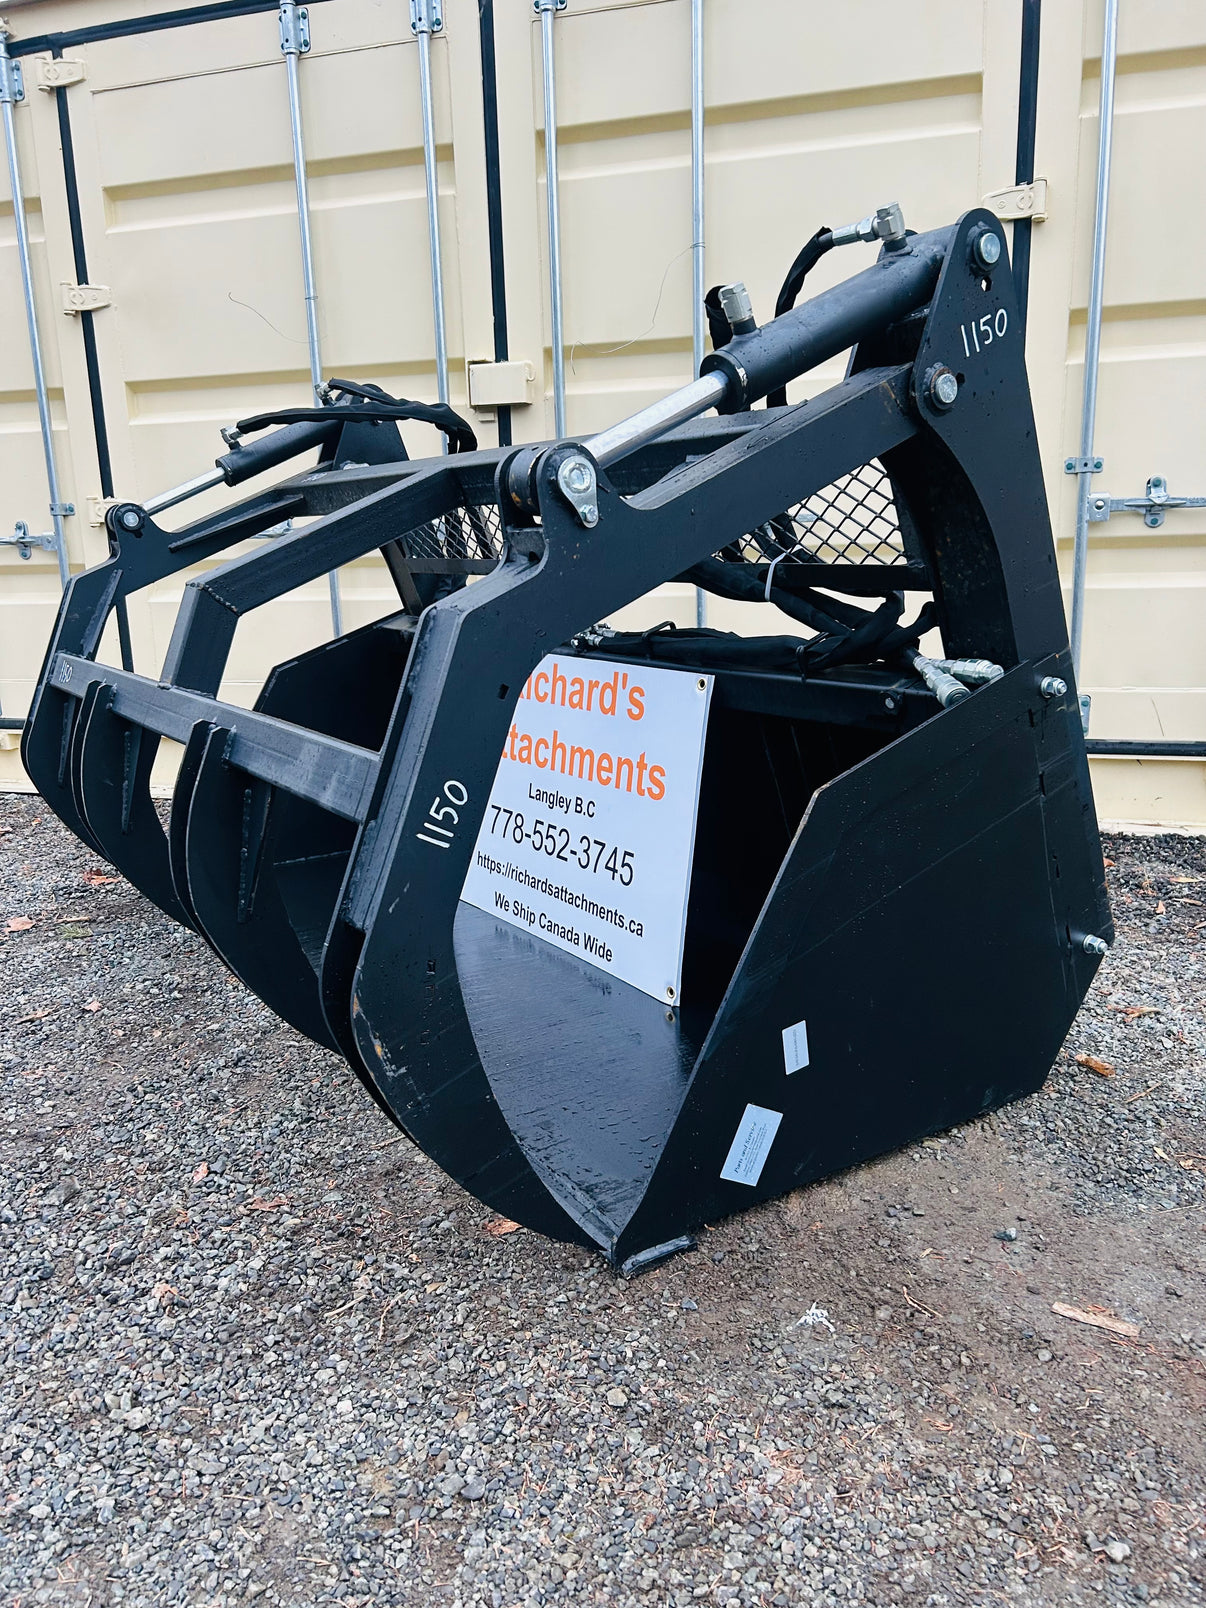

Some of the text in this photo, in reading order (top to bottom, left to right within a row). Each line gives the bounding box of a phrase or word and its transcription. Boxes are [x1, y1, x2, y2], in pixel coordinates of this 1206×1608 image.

[961, 308, 1007, 357] 1150
[519, 663, 646, 721] ichard's
[502, 723, 666, 801] tachments
[416, 780, 468, 848] 1150
[528, 783, 596, 818] Langley B.C
[491, 804, 635, 887] 778-552-3745
[477, 851, 644, 938] https://richardsattachments.ca
[494, 891, 614, 963] We Ship Canada Wide
